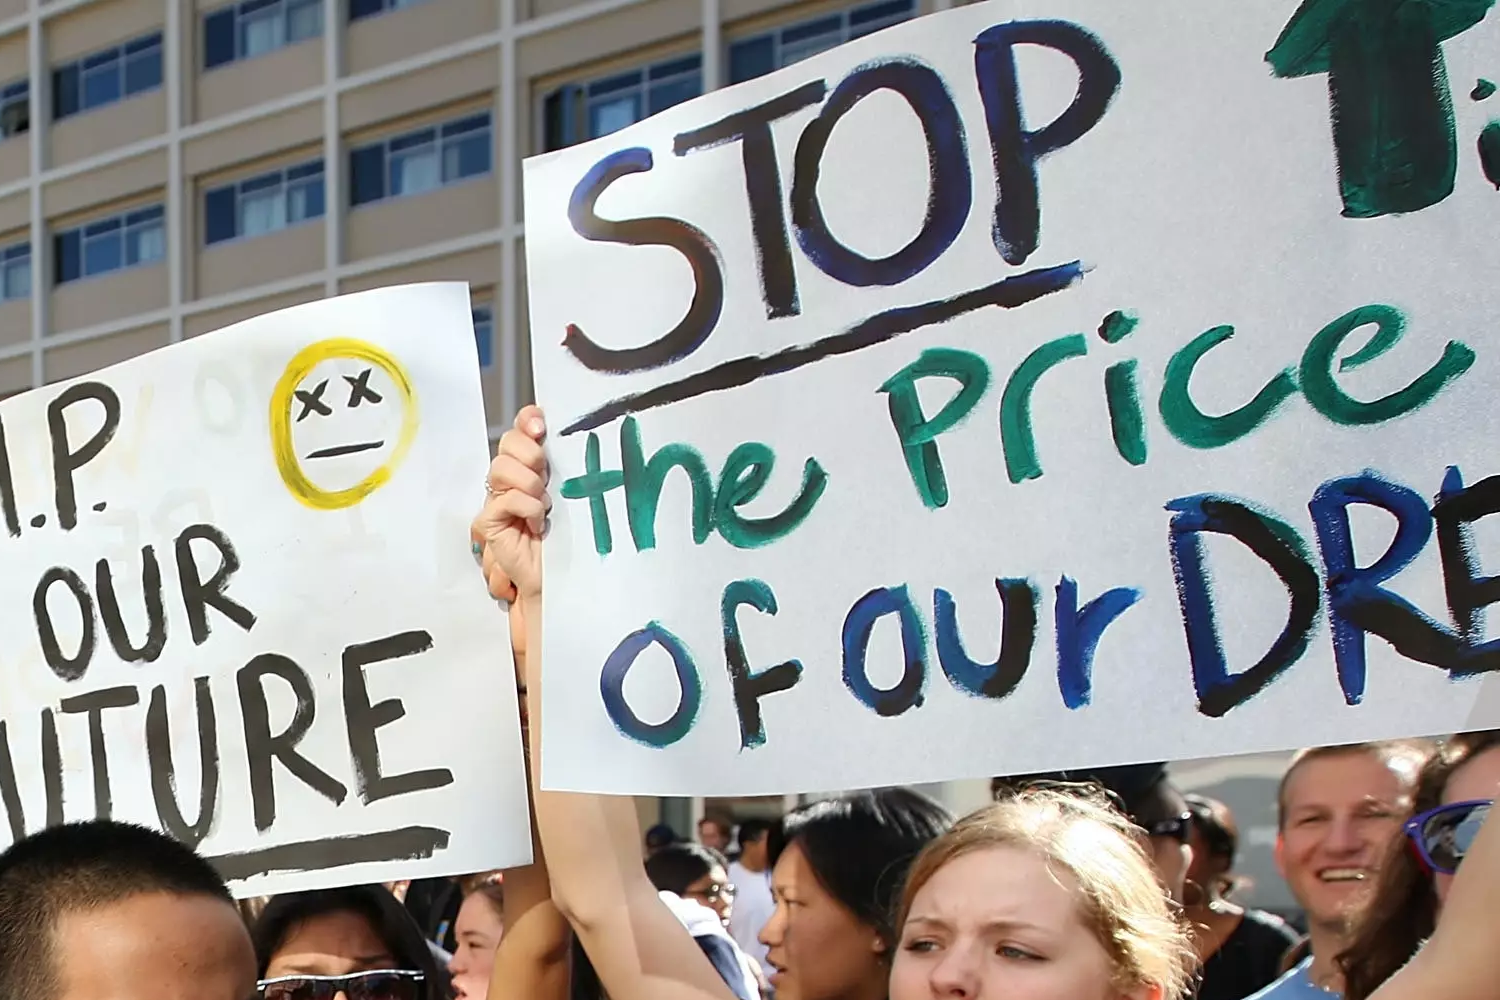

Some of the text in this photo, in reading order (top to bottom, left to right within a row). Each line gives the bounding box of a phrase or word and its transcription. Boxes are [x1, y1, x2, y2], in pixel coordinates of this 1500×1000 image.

[561, 17, 1123, 374] STOP
[561, 415, 830, 558] the
[32, 522, 257, 682] OUR
